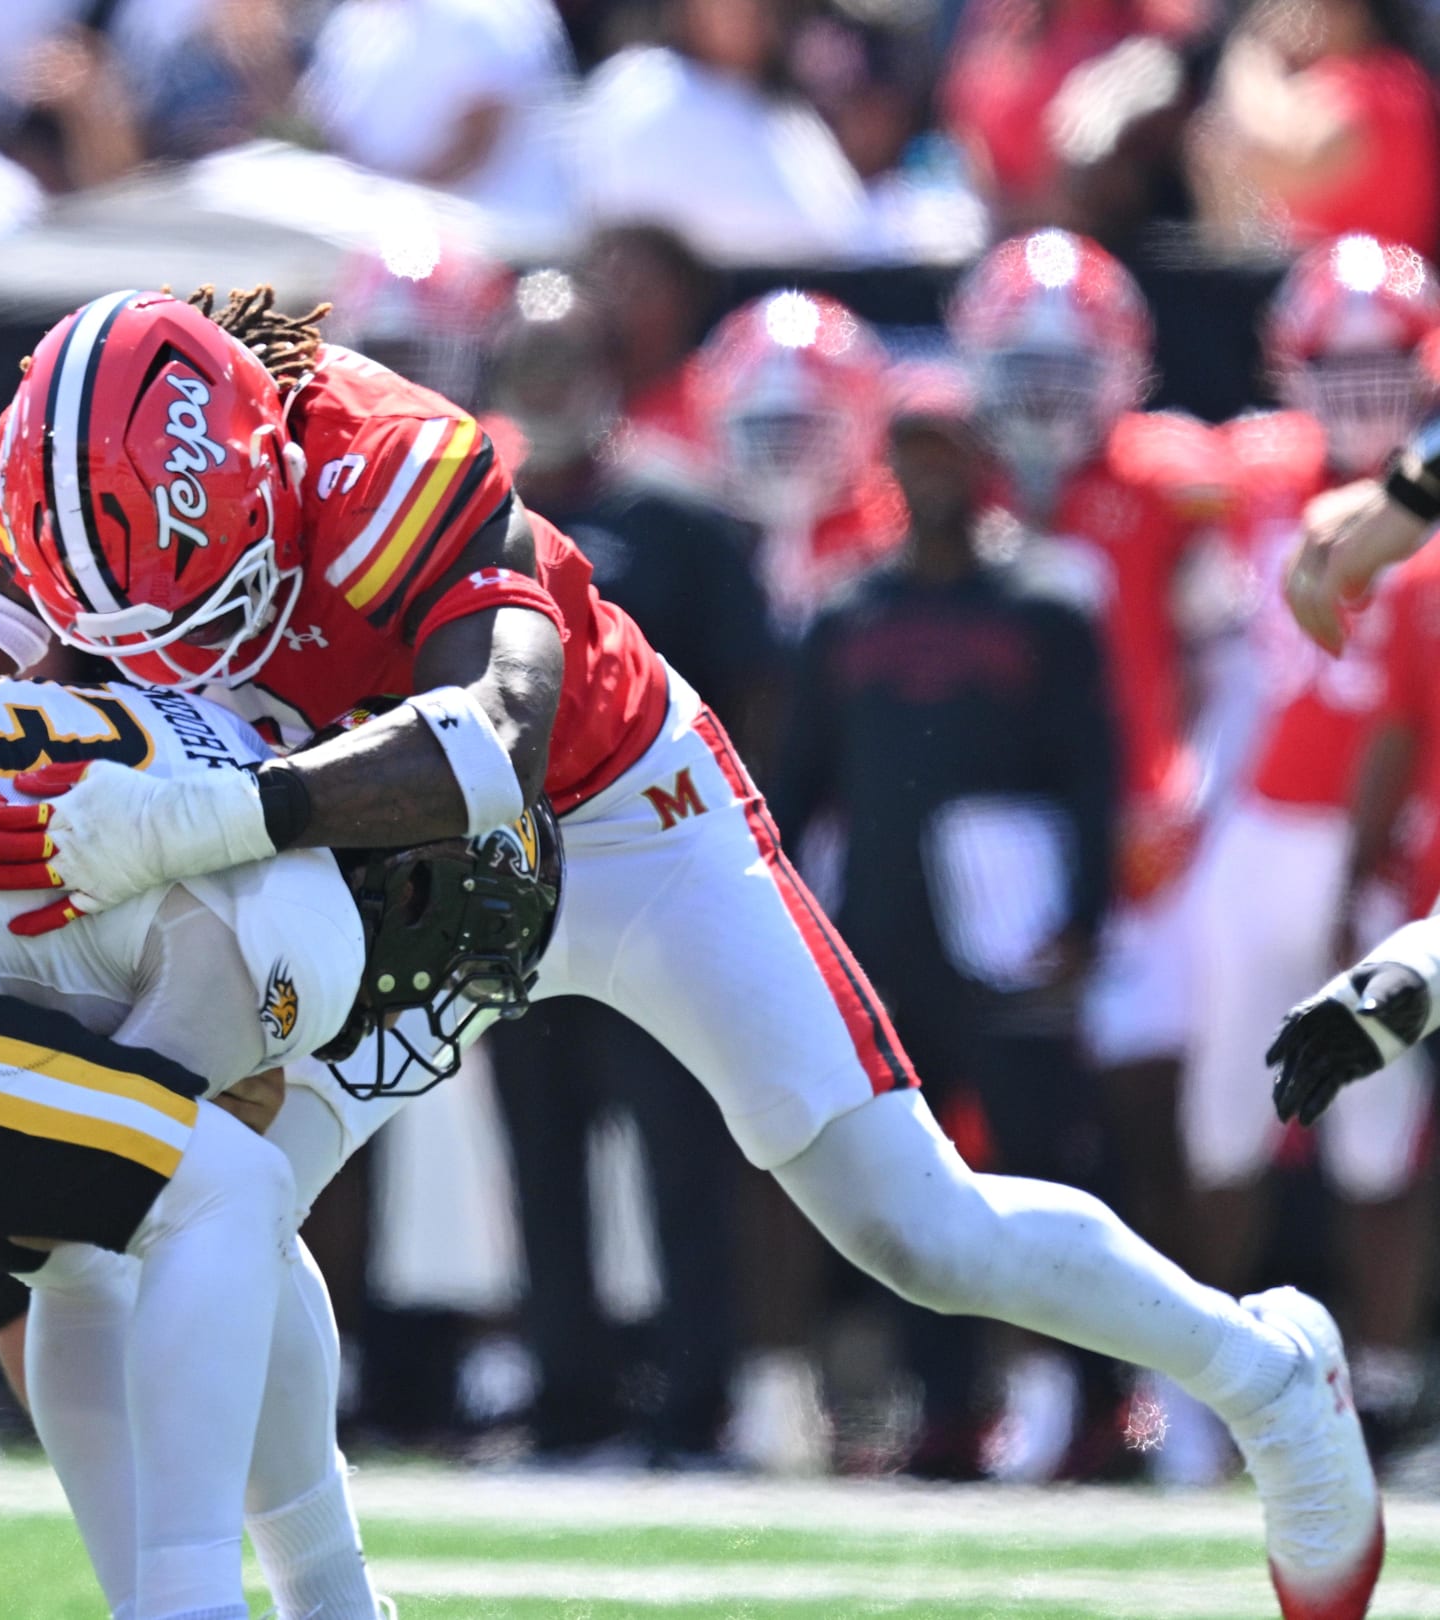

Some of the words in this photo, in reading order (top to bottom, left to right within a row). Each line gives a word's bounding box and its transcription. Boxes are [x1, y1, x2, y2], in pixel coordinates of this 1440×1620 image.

[155, 374, 227, 549] Terps
[138, 684, 242, 769] NDORF
[640, 766, 709, 832] M
